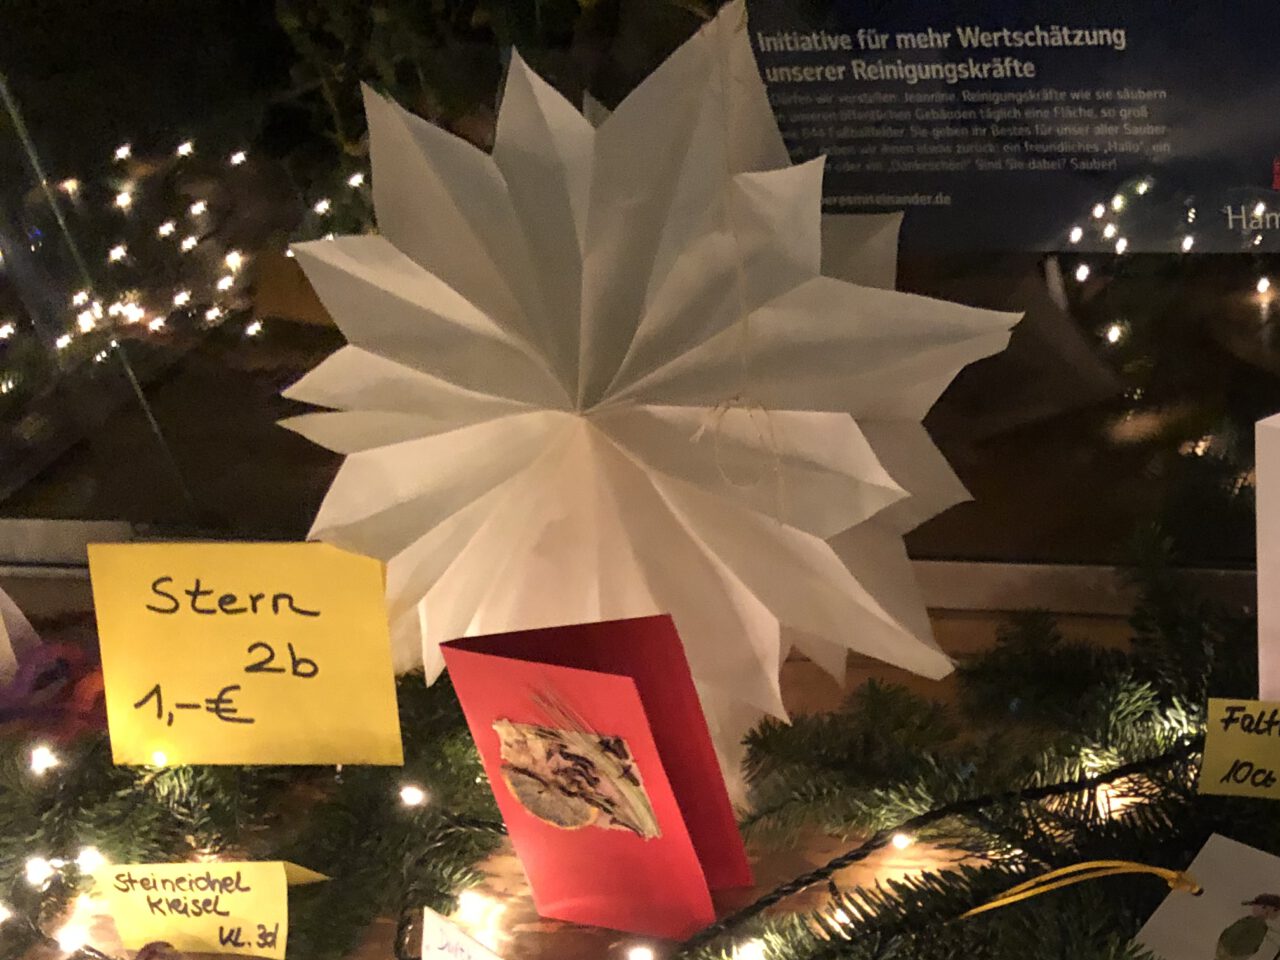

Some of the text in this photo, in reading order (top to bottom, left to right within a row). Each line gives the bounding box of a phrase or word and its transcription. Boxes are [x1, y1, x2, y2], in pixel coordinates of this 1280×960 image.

[757, 23, 1128, 53] Initiative für mehr Wertschätzung
[765, 57, 1036, 85] unserer Reinigungskräfte
[1116, 87, 1167, 101] säubern
[145, 575, 321, 617] Stern
[244, 641, 320, 678] 2b
